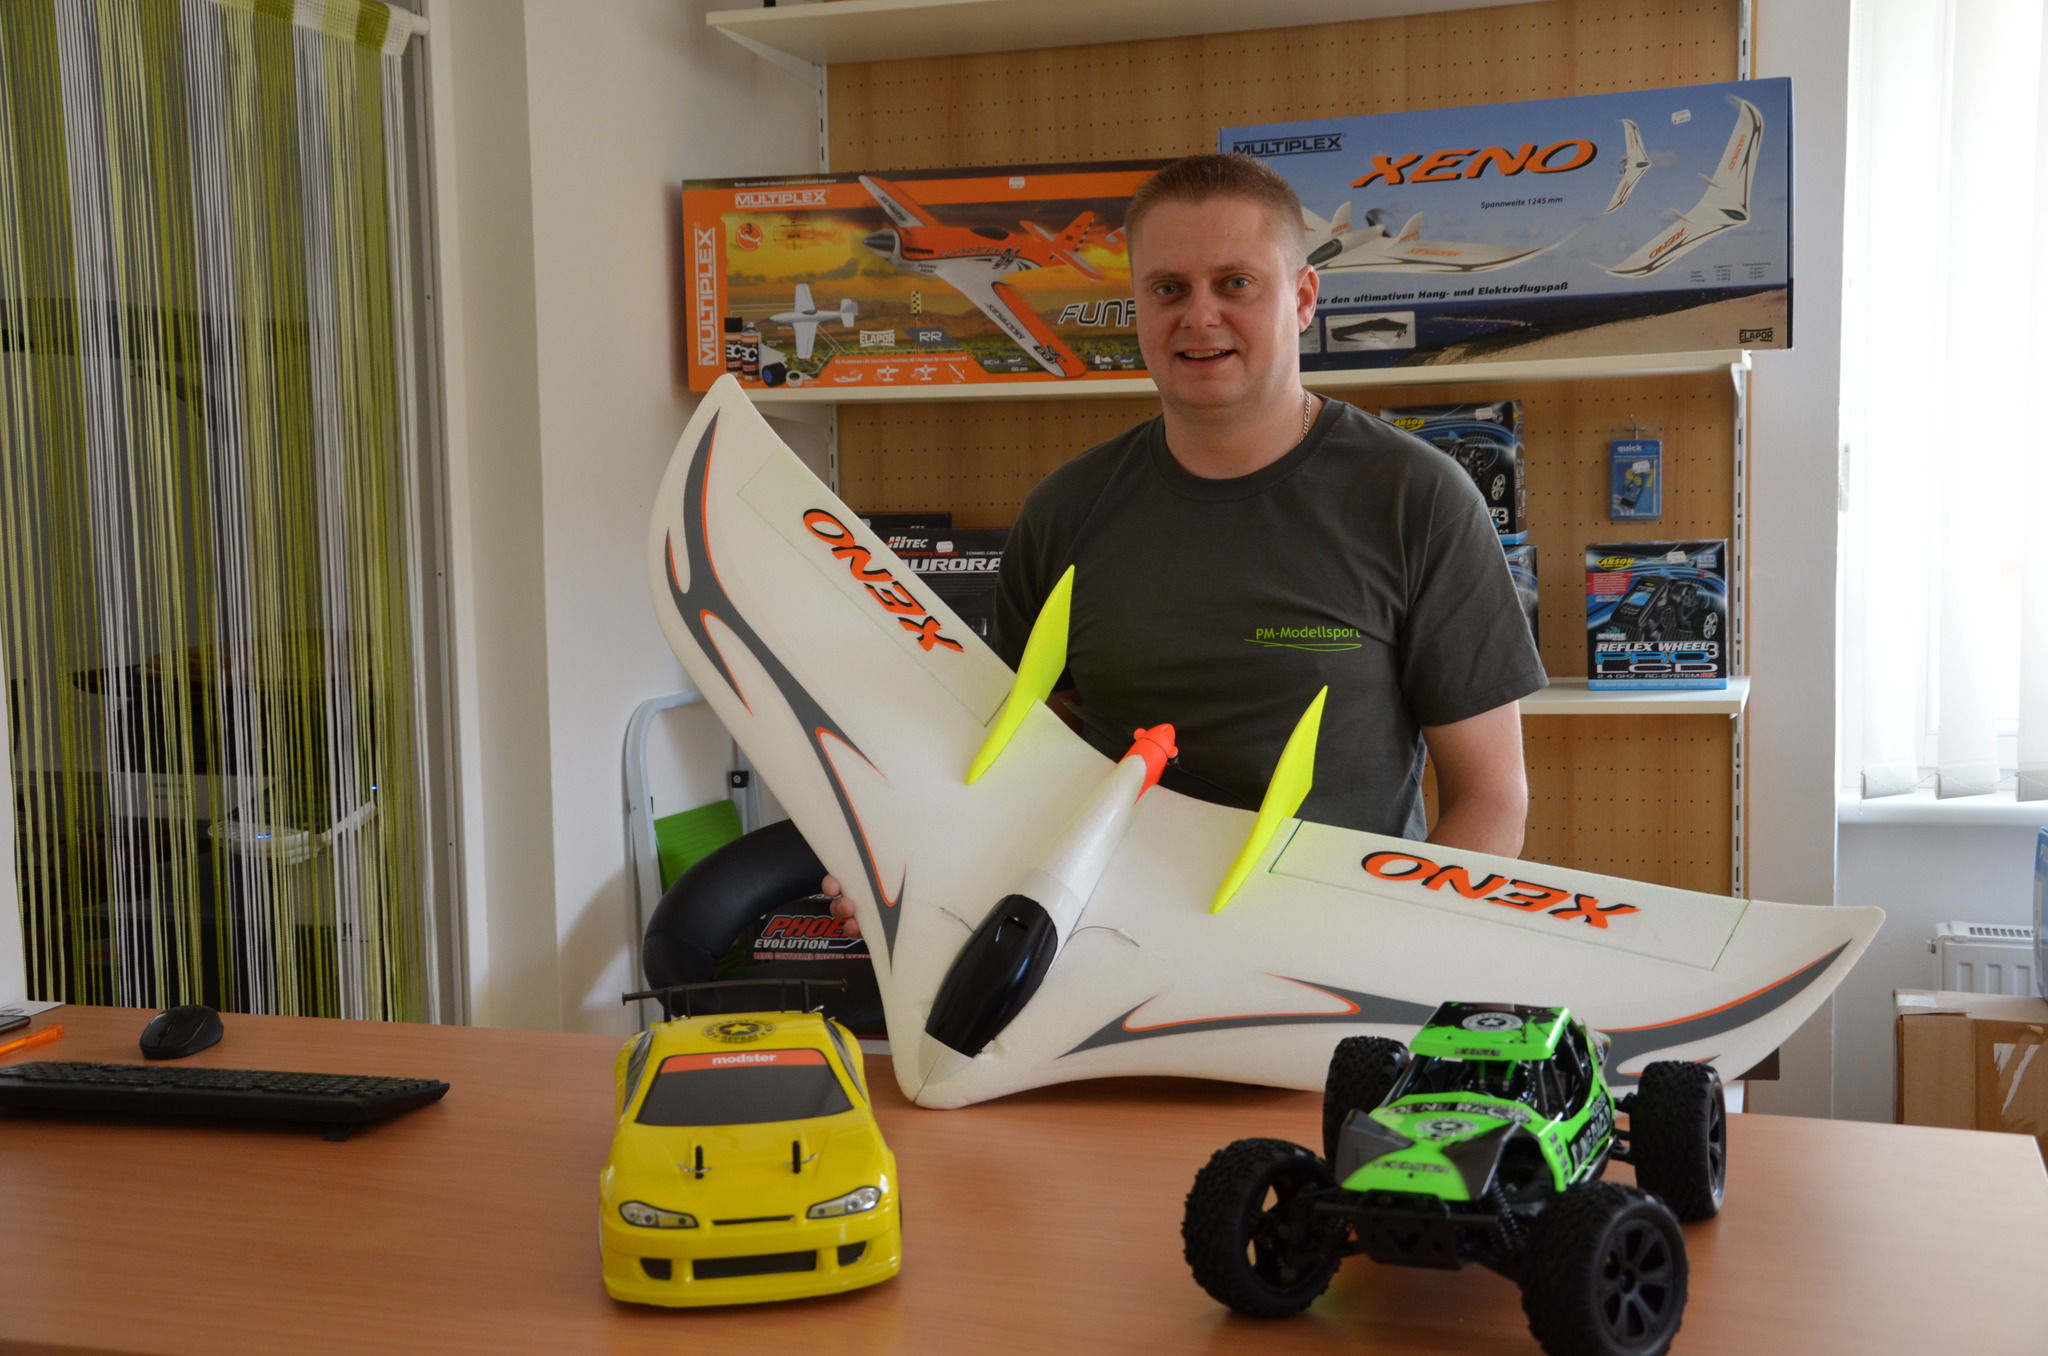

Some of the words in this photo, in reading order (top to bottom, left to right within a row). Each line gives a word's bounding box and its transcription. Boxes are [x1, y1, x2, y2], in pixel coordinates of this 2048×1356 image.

[1233, 135, 1342, 156] MULTIPLEX
[1348, 139, 1598, 188] XENO
[734, 189, 826, 207] MULTIPLEX
[1480, 199, 1526, 210] Spannweite
[1528, 197, 1546, 206] 1245
[745, 223, 753, 235] 3
[697, 228, 716, 365] MULTIPLEX
[1316, 295, 1327, 305] ür
[1331, 296, 1350, 304] den
[1354, 291, 1415, 303] ultimativen
[1418, 290, 1450, 300] Hang-
[1454, 288, 1474, 297] und
[1477, 281, 1569, 295] Elektroflugspaß
[860, 332, 895, 345] ELAPOR
[919, 331, 942, 341] RR
[1739, 330, 1774, 341] ELAPOR
[1617, 444, 1643, 454] quick
[1595, 557, 1636, 566] CARSON
[802, 508, 965, 653] XENO
[1597, 642, 1654, 652] REFLEX
[1658, 641, 1709, 652] WHEEL
[1596, 651, 1711, 664] PRO
[1596, 663, 1719, 674] LCD
[1361, 851, 1642, 929] XENO
[754, 939, 829, 949] EVOLUTION
[711, 1054, 777, 1065] modster
